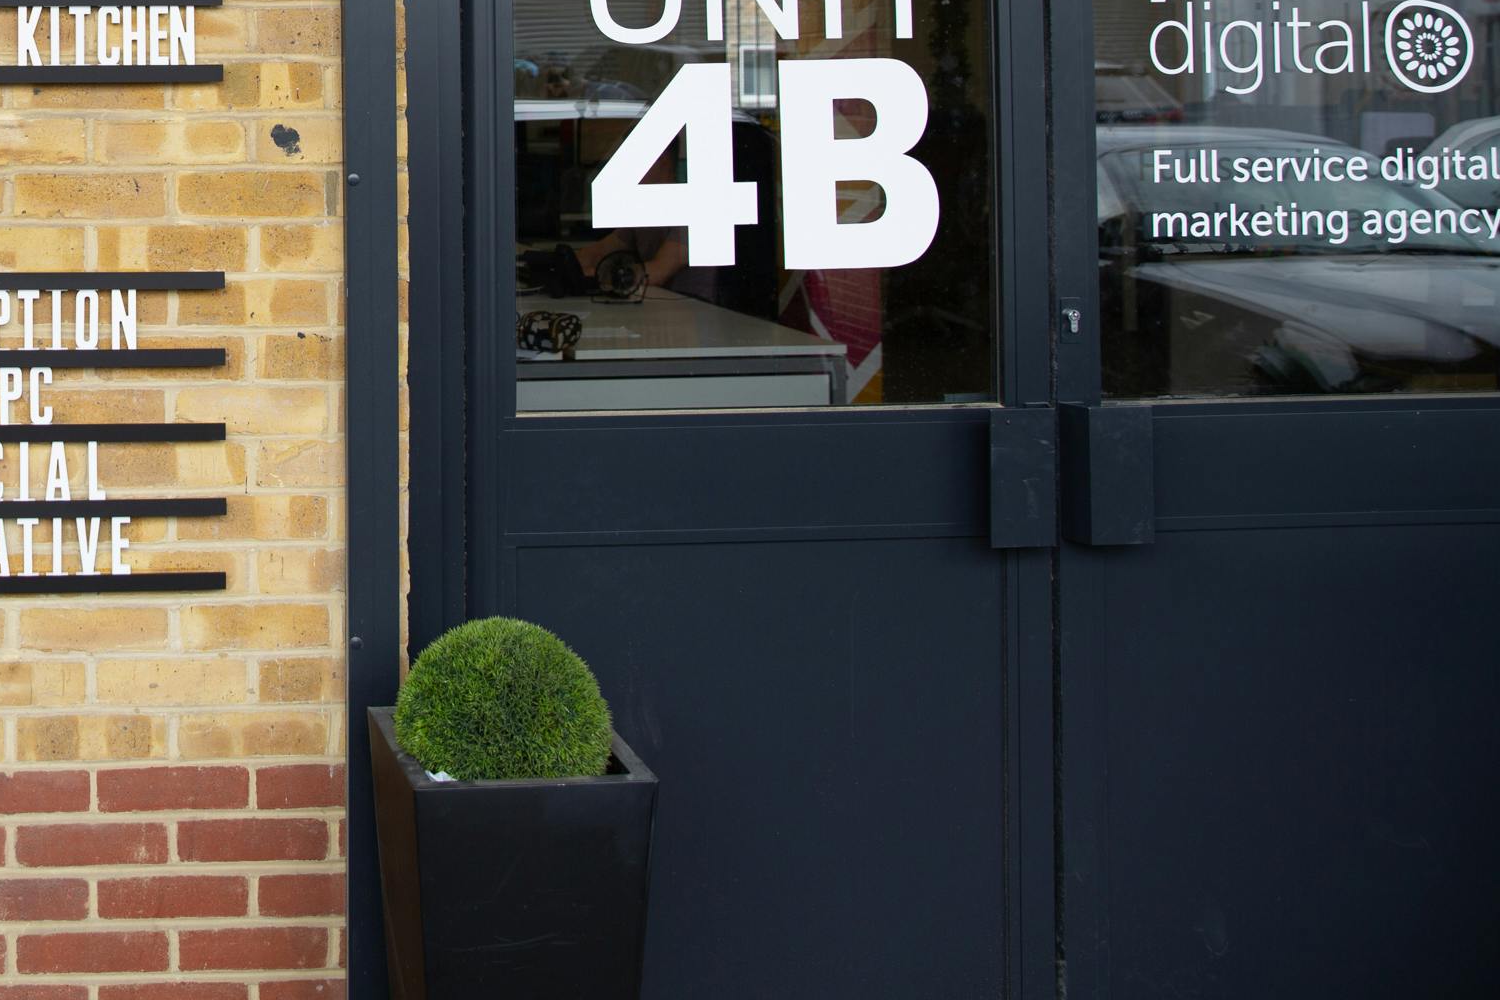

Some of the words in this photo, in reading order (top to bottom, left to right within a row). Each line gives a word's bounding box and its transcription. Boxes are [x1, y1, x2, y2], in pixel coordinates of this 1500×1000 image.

[17, 6, 196, 67] KITCHEN
[1150, 1, 1370, 95] digital
[591, 57, 940, 270] 4B
[1153, 149, 1221, 184] Full
[1233, 148, 1368, 183] service
[1381, 147, 1500, 190] digital
[1153, 203, 1348, 244] marketing
[1363, 208, 1500, 244] agency
